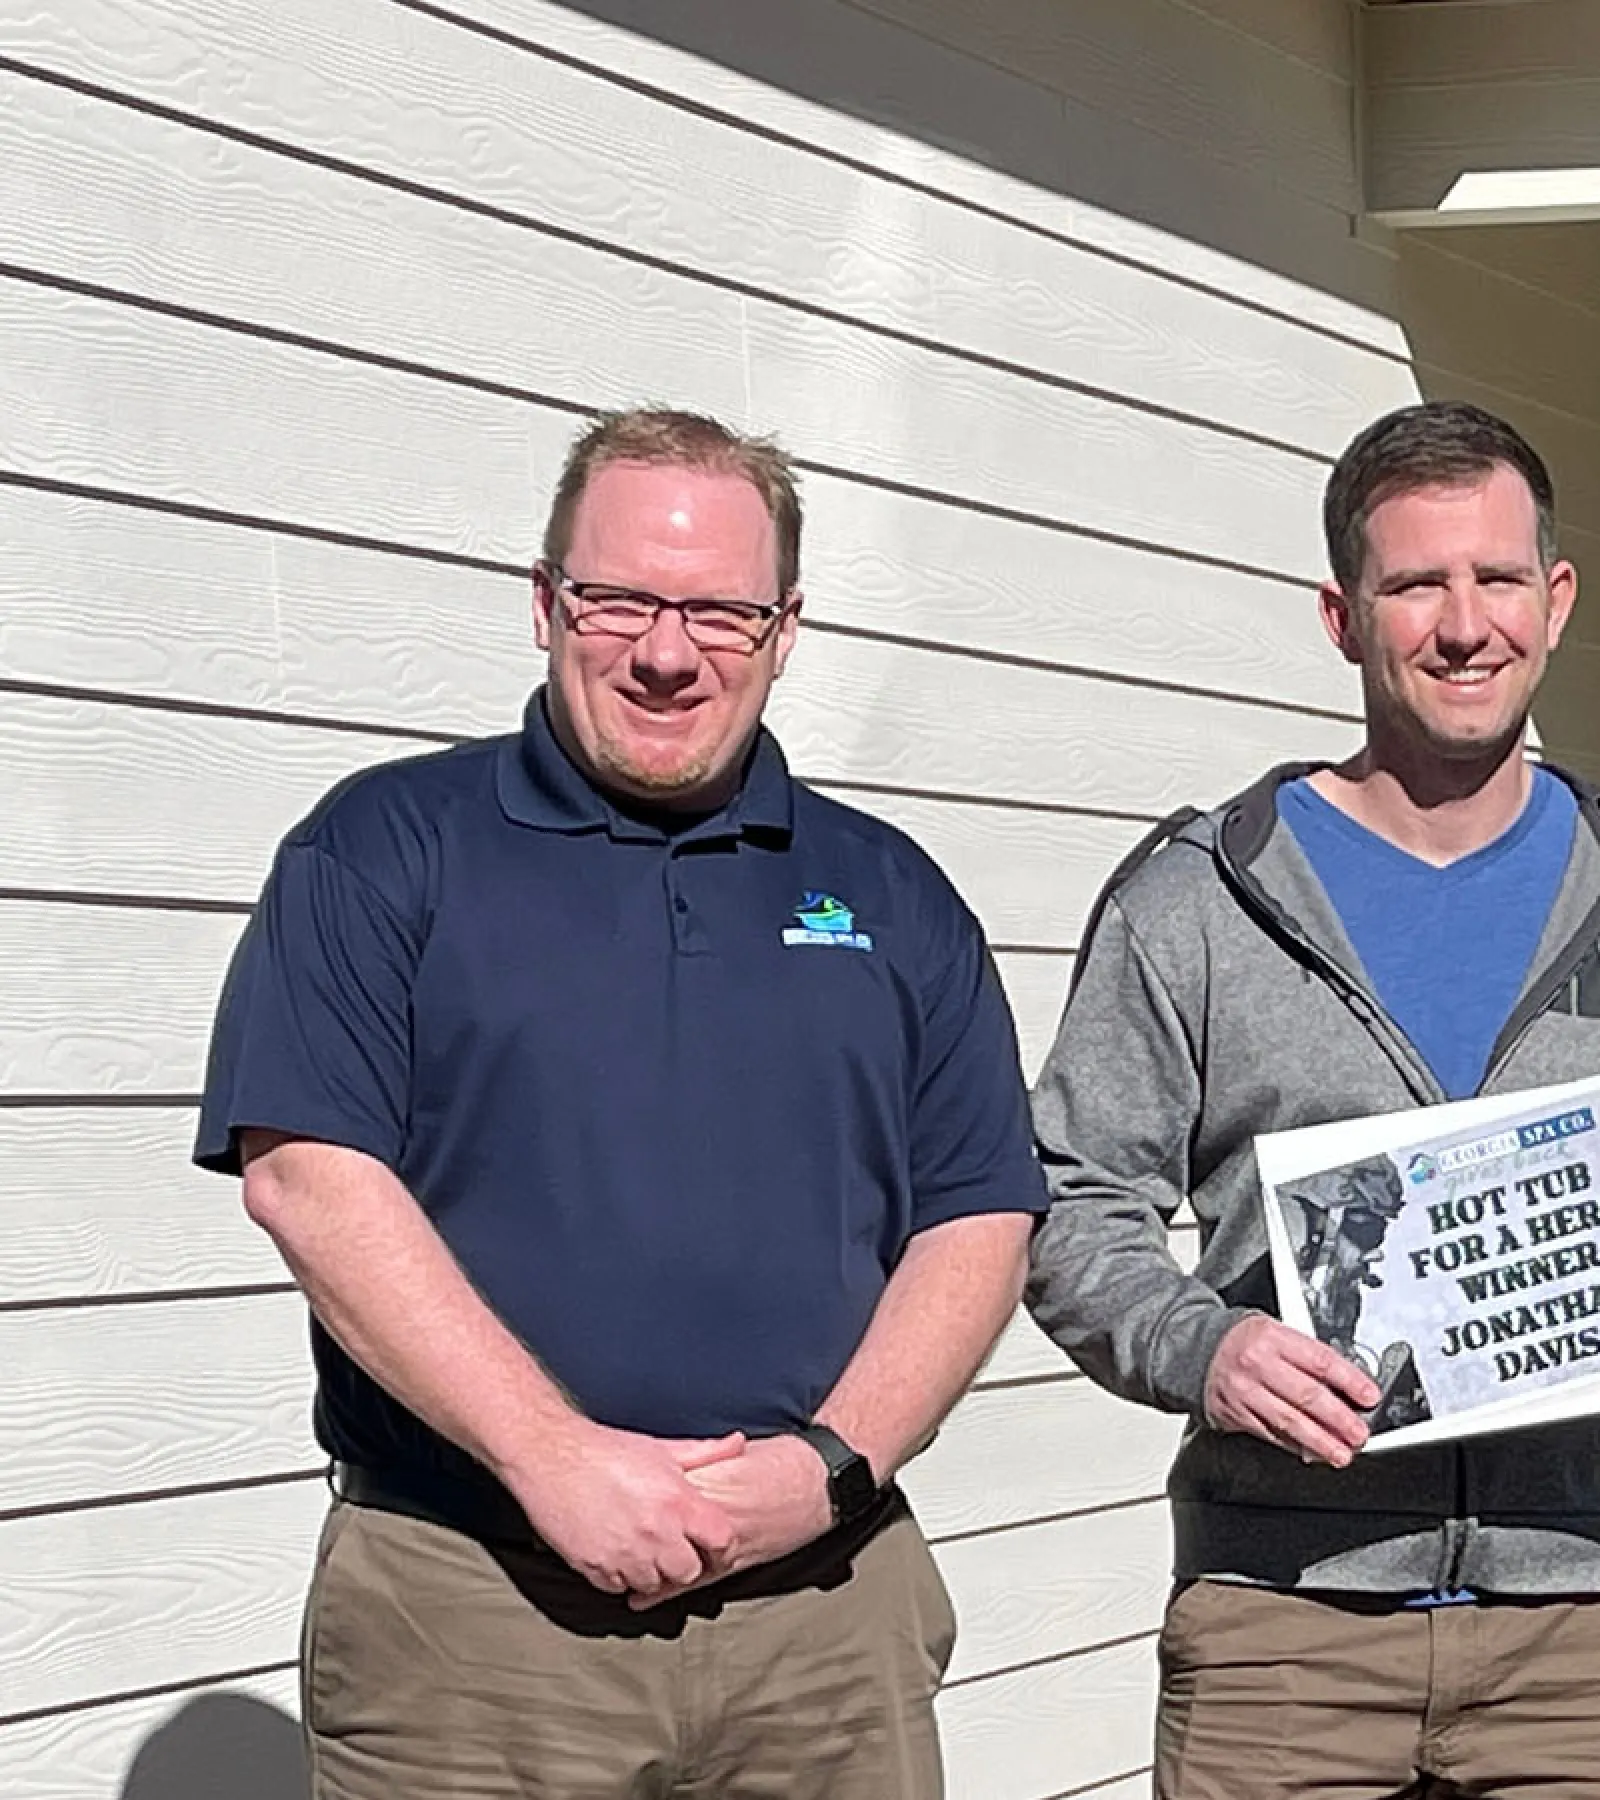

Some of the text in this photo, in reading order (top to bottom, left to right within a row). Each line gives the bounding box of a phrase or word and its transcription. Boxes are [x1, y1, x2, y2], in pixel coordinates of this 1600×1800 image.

[1523, 1123, 1557, 1144] SPA
[1426, 1162, 1592, 1234] HOT TUB
[1408, 1235, 1489, 1279] FOR
[1497, 1225, 1522, 1257] A
